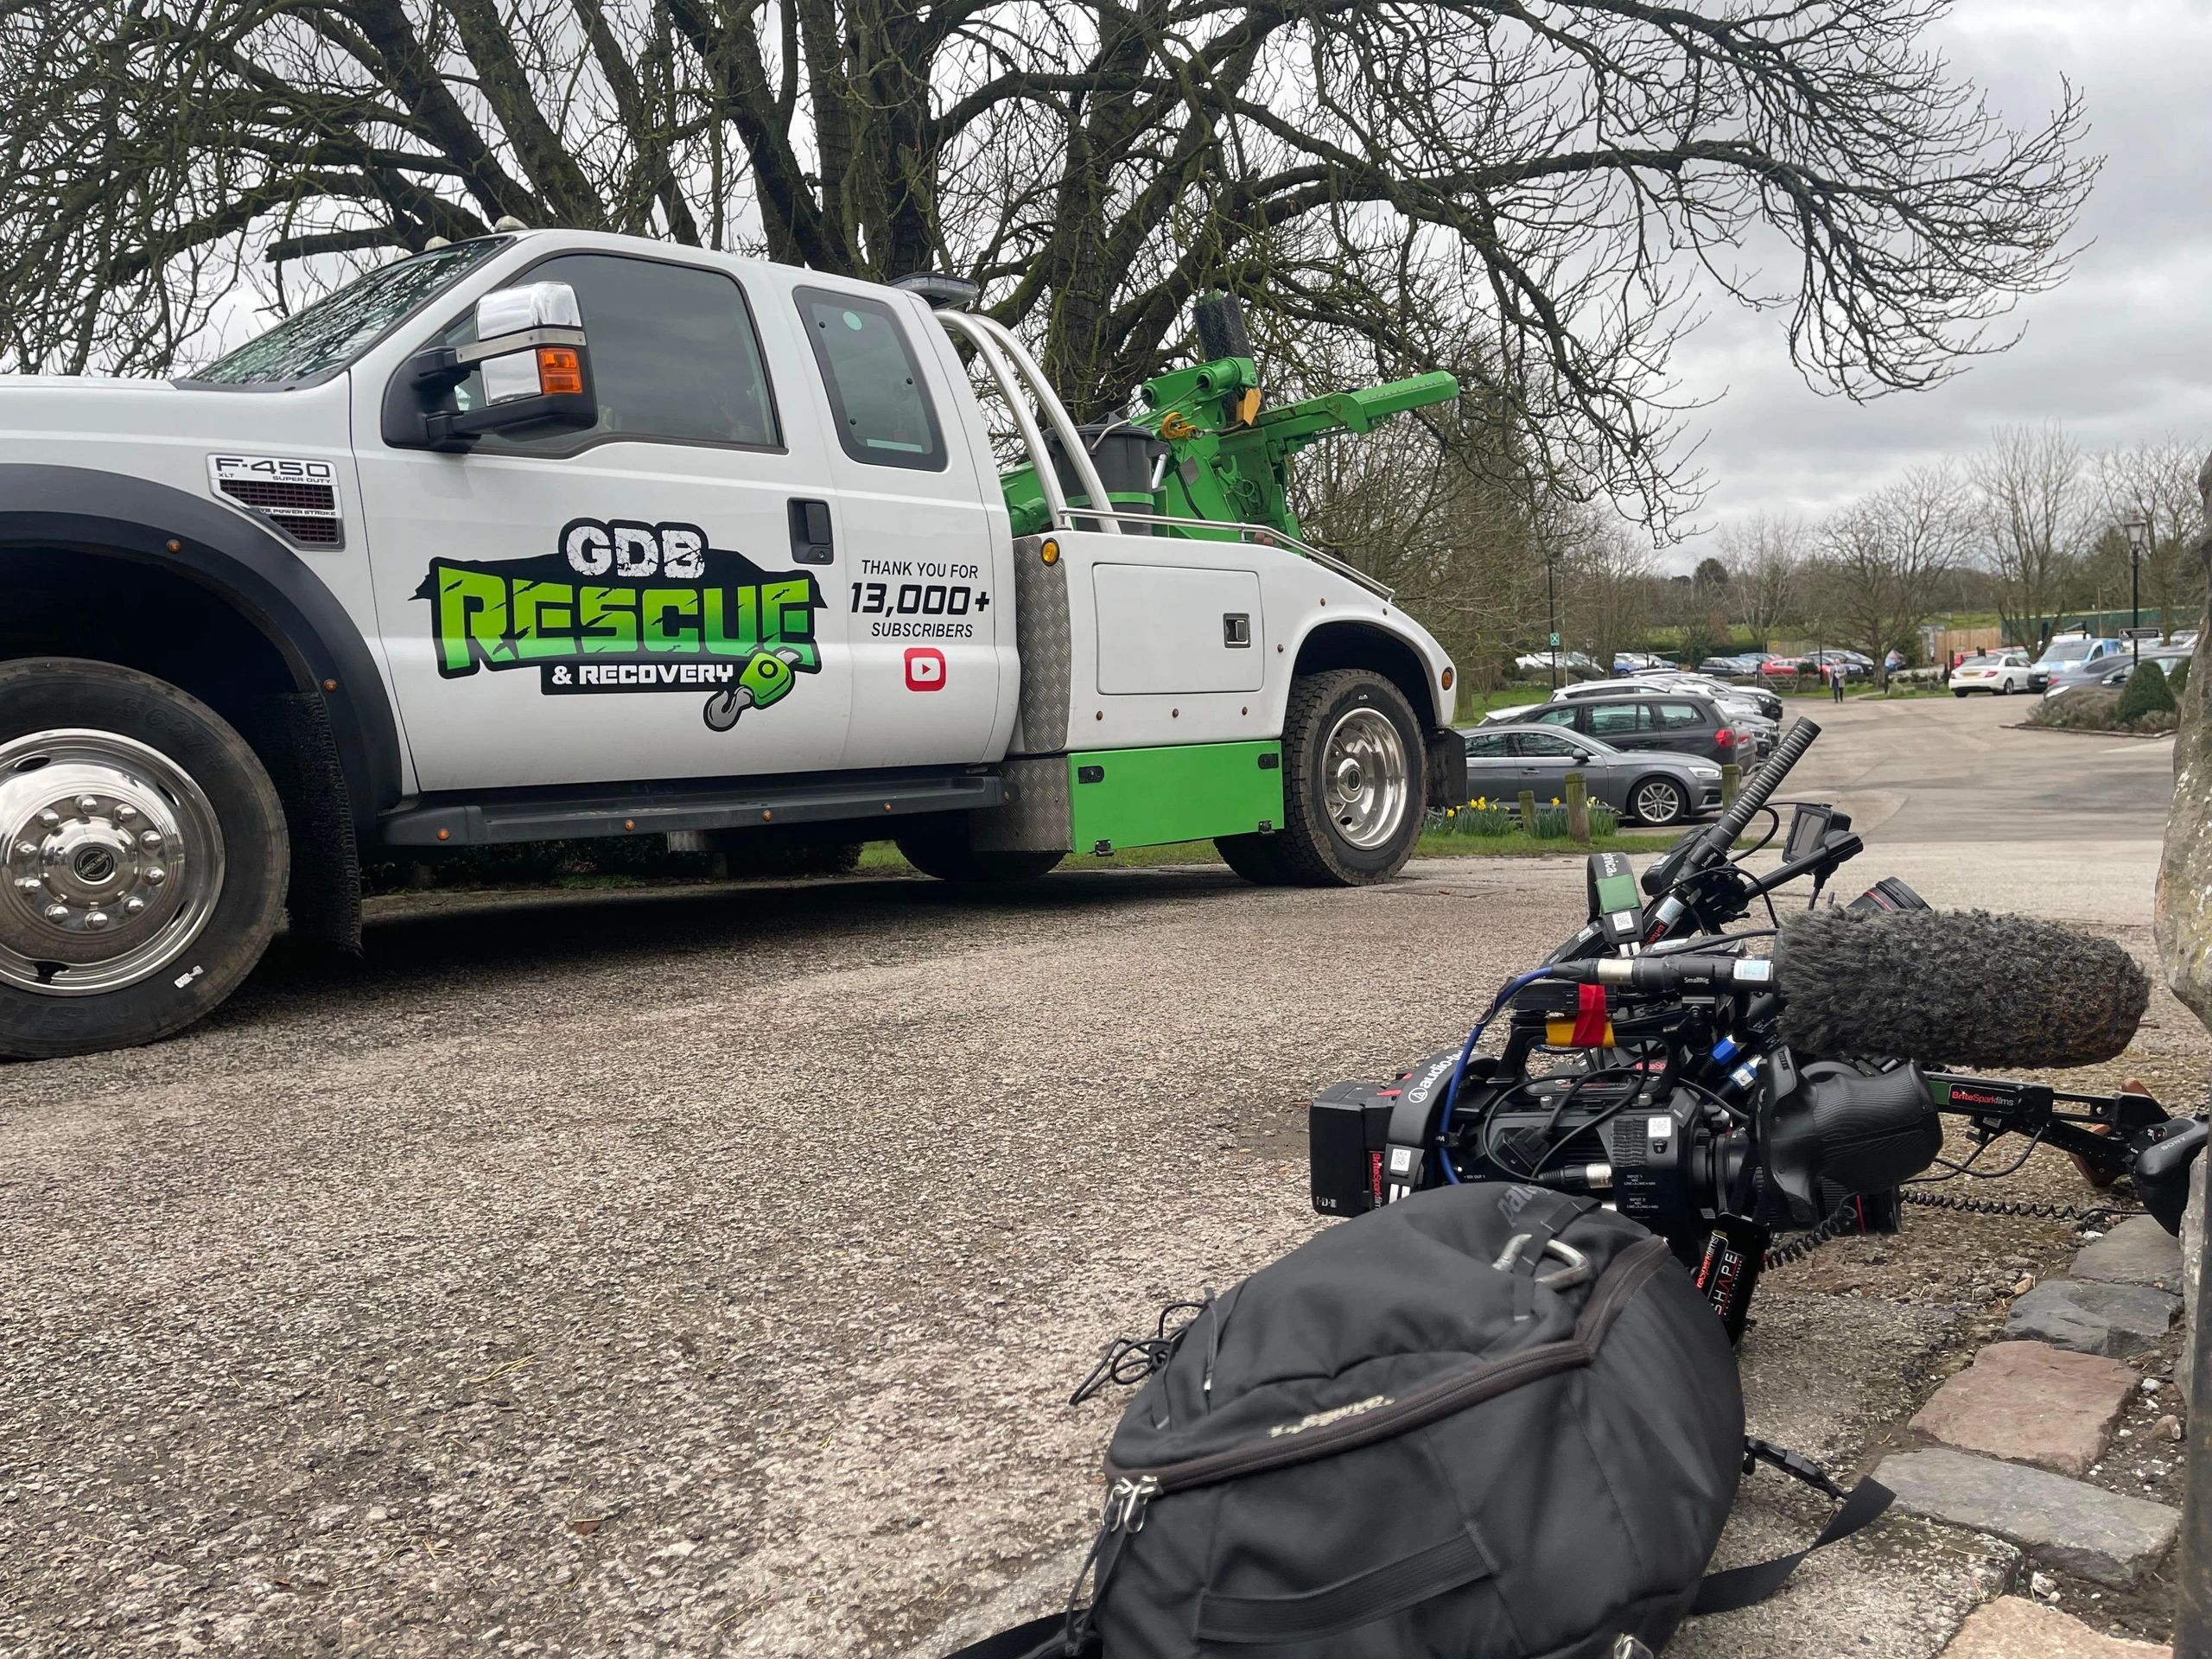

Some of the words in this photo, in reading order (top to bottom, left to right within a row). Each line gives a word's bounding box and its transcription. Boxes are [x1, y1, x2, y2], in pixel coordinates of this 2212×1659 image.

[216, 458, 330, 478] F-450
[566, 525, 705, 579] GDB
[861, 559, 912, 576] THANK
[917, 562, 946, 577] YOU
[950, 564, 978, 579] FOR
[851, 582, 990, 618] 13,000+
[438, 566, 816, 671] RESCUE
[871, 622, 973, 638] SUBSCRIBERS
[551, 664, 572, 685] &
[579, 664, 734, 685] RECOVERY
[1951, 1090, 2014, 1106] BriteSparkfilms
